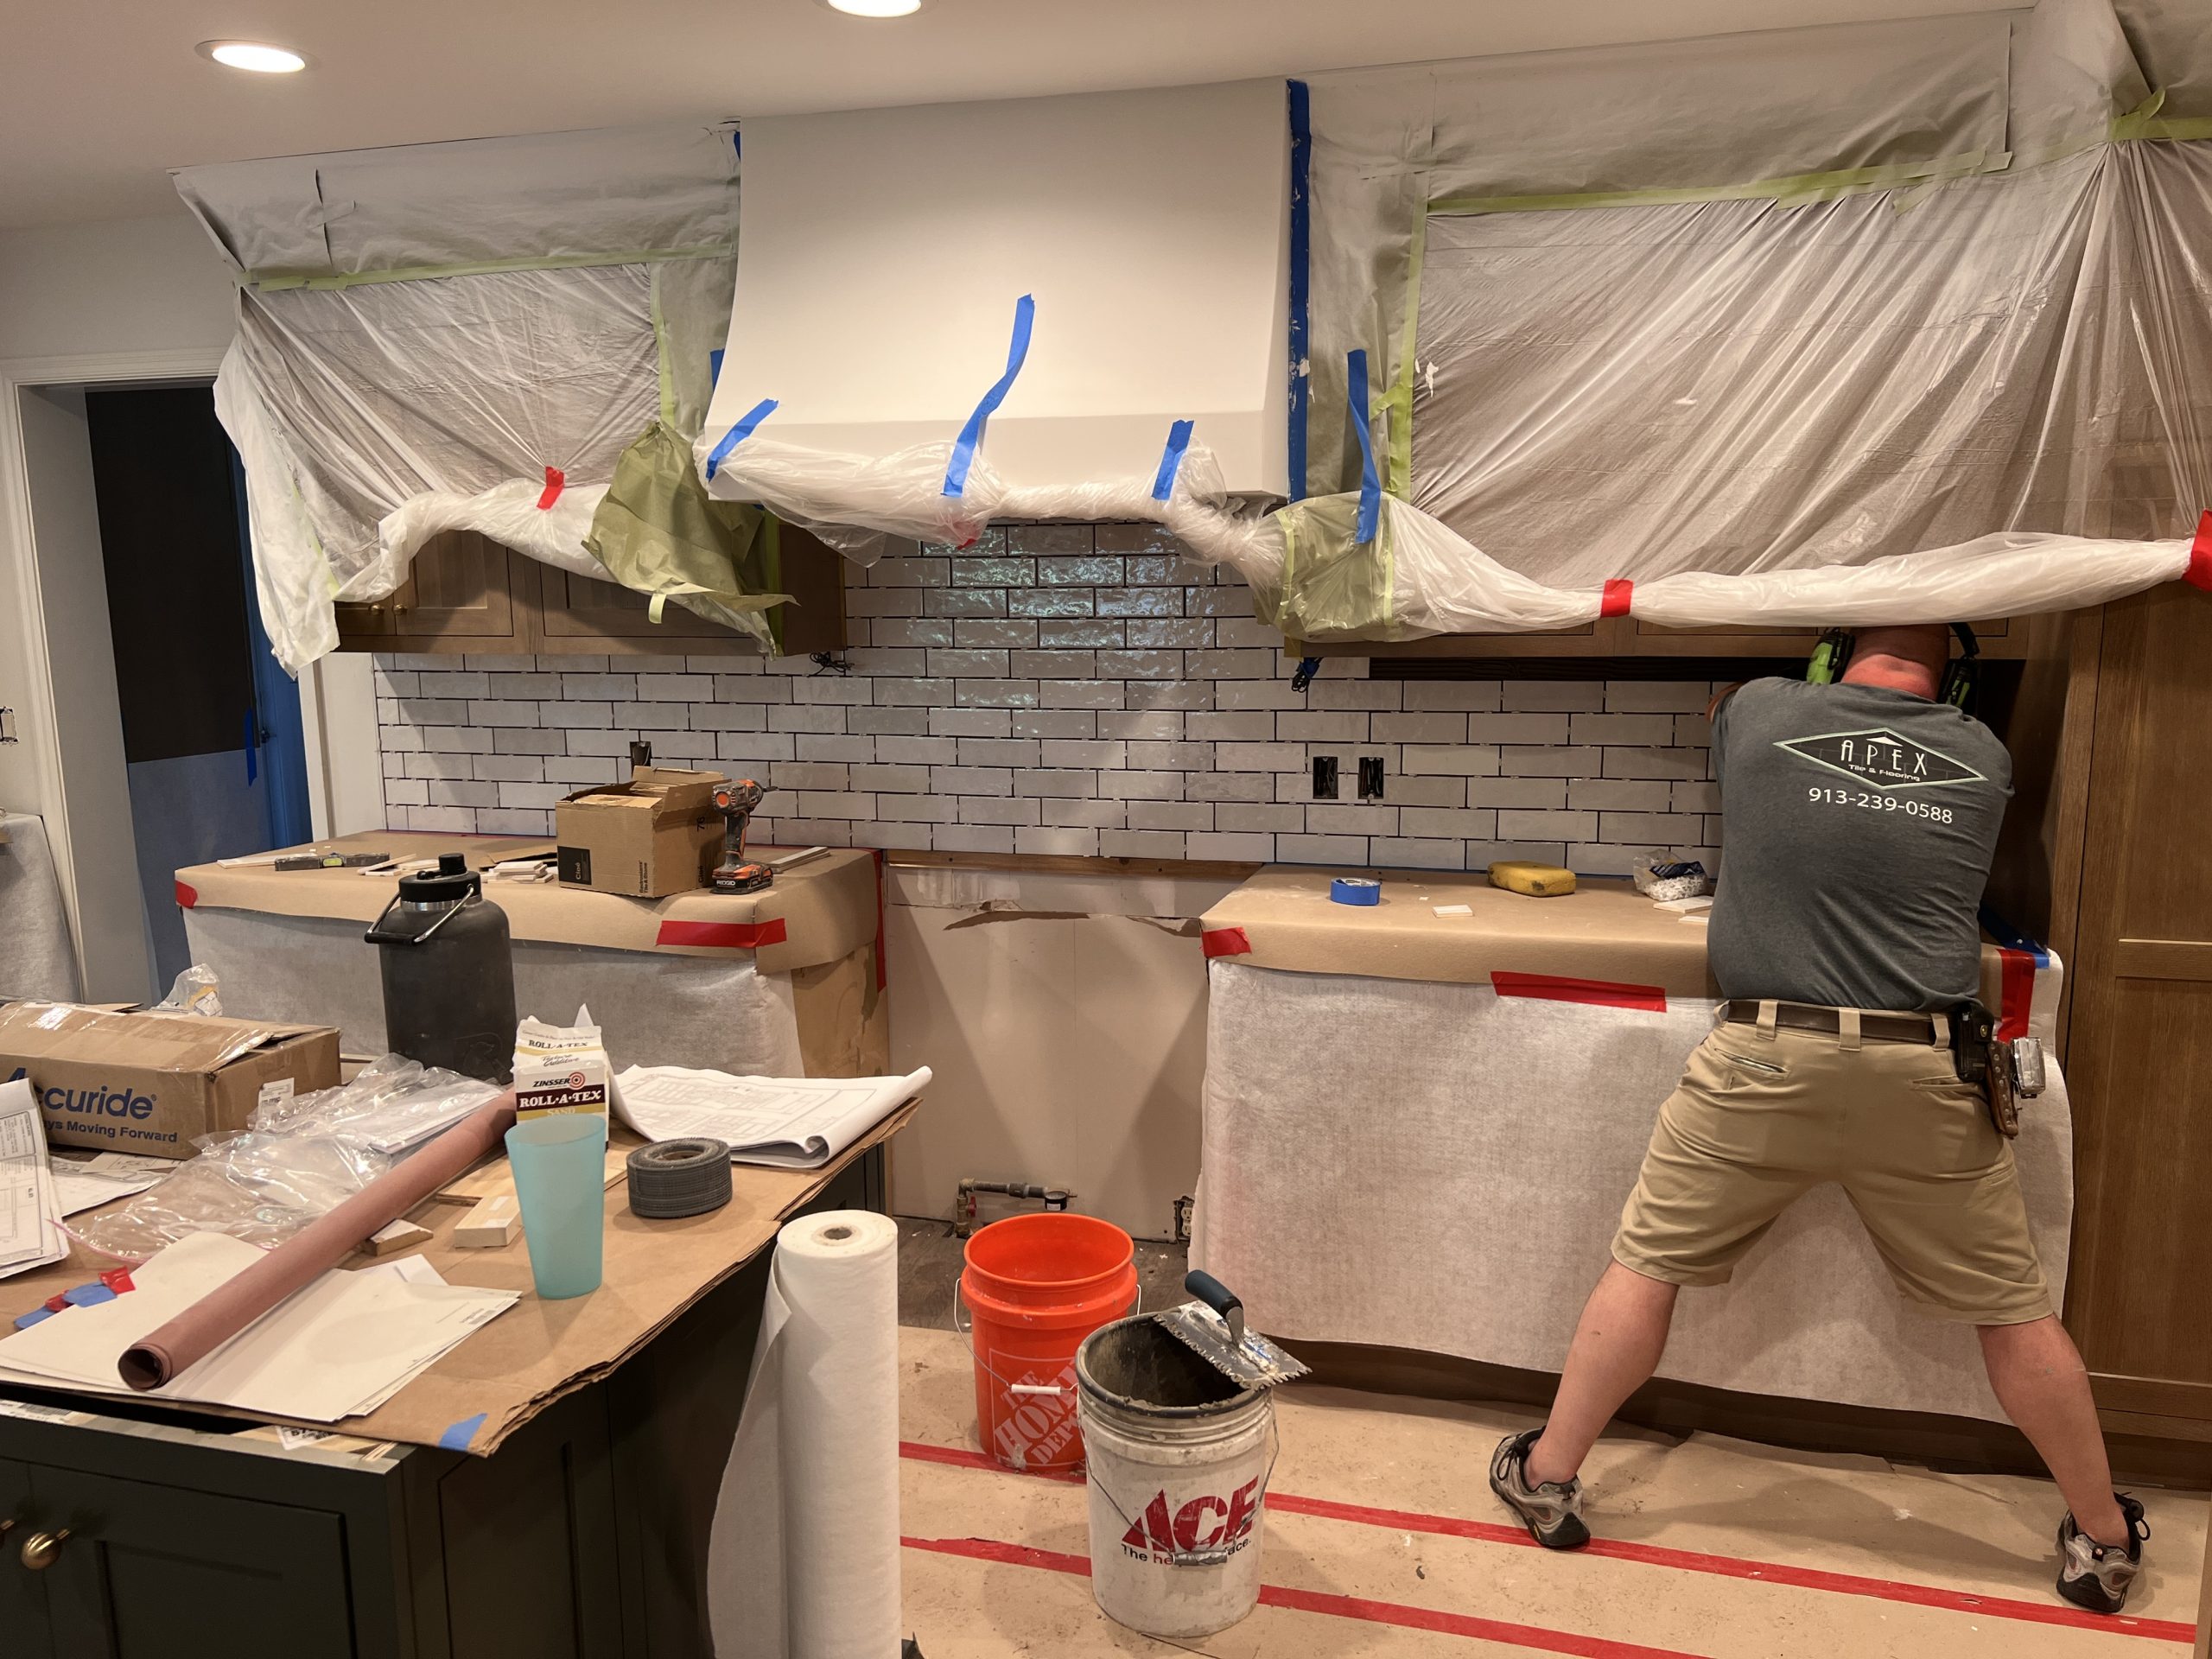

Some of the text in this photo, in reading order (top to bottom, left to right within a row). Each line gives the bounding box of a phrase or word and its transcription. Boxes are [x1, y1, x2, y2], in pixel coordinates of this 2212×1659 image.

[1840, 740, 1927, 776] APEX
[1878, 769, 1921, 782] Flooring
[1808, 787, 1953, 824] 913-239-0588
[532, 1077, 571, 1088] ZINSSER
[67, 1121, 116, 1138] Moving
[119, 1127, 178, 1142] Forward
[1122, 1474, 1259, 1553] ACE
[1122, 1543, 1147, 1562] The
